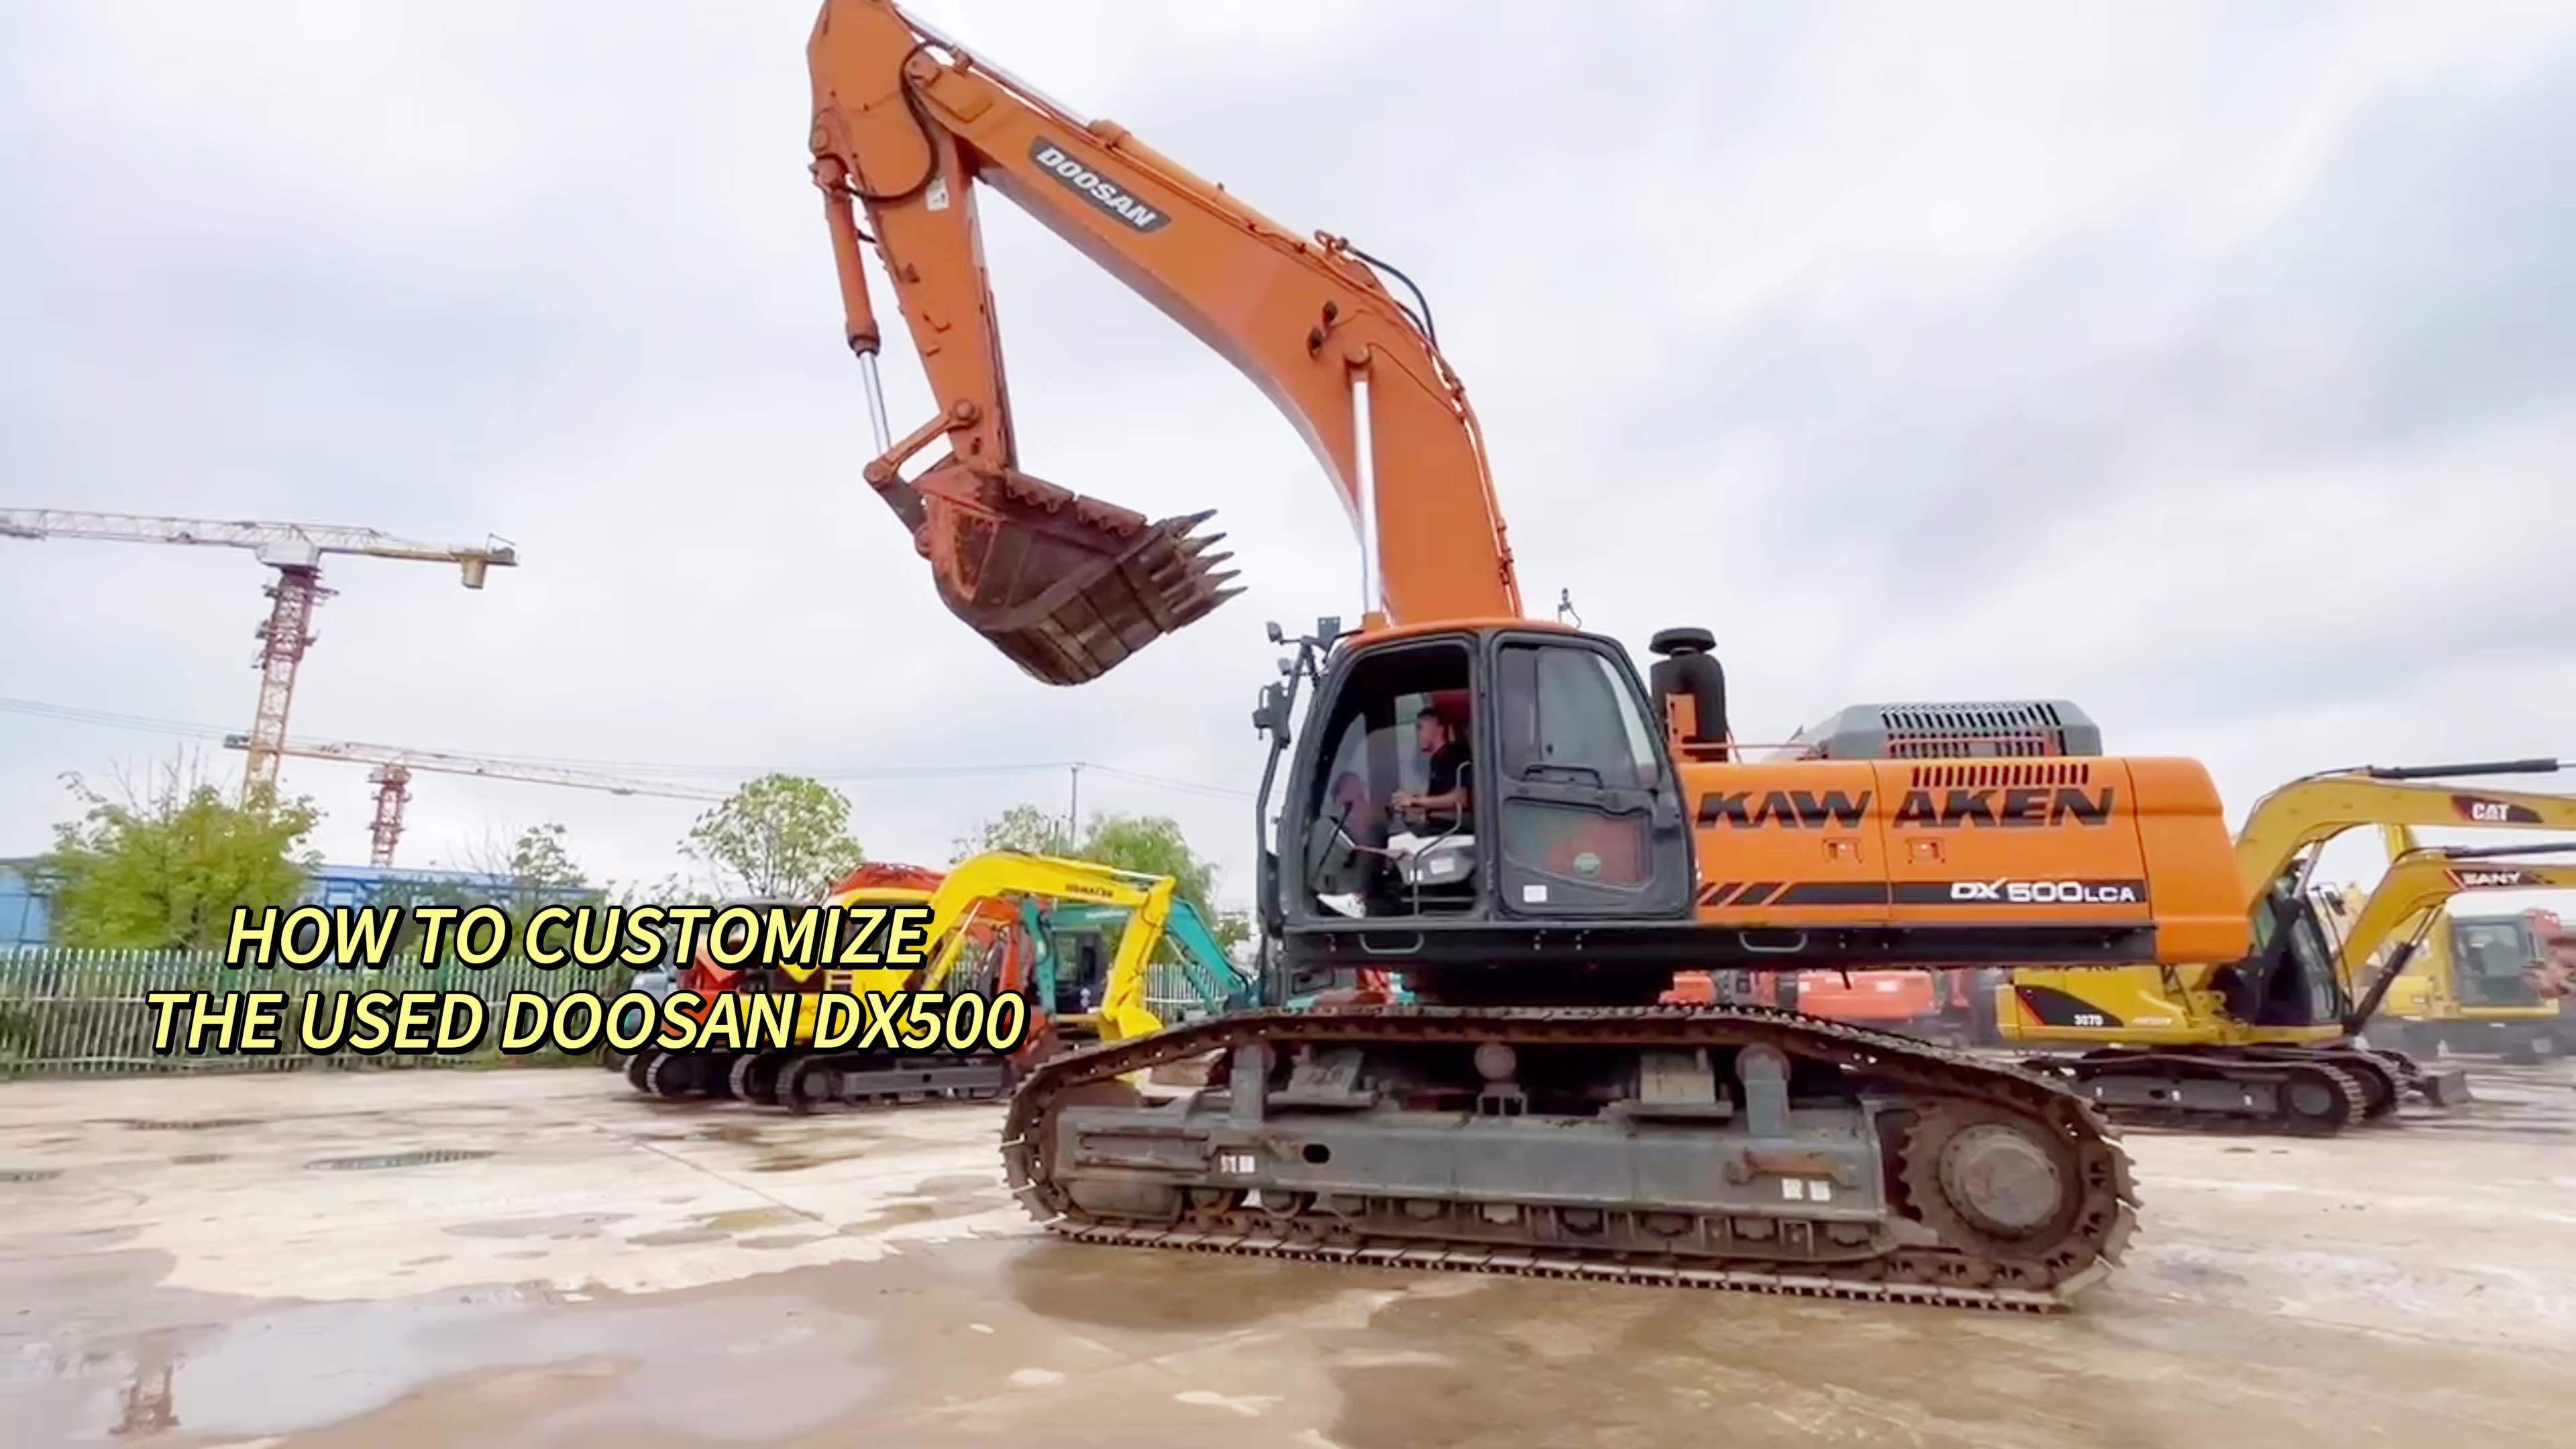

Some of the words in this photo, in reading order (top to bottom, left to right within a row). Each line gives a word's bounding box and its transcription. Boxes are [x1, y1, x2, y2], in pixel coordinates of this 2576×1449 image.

[1035, 146, 1158, 227] DOOSAN
[2471, 802, 2510, 822] CAT
[2461, 871, 2521, 885] SANY
